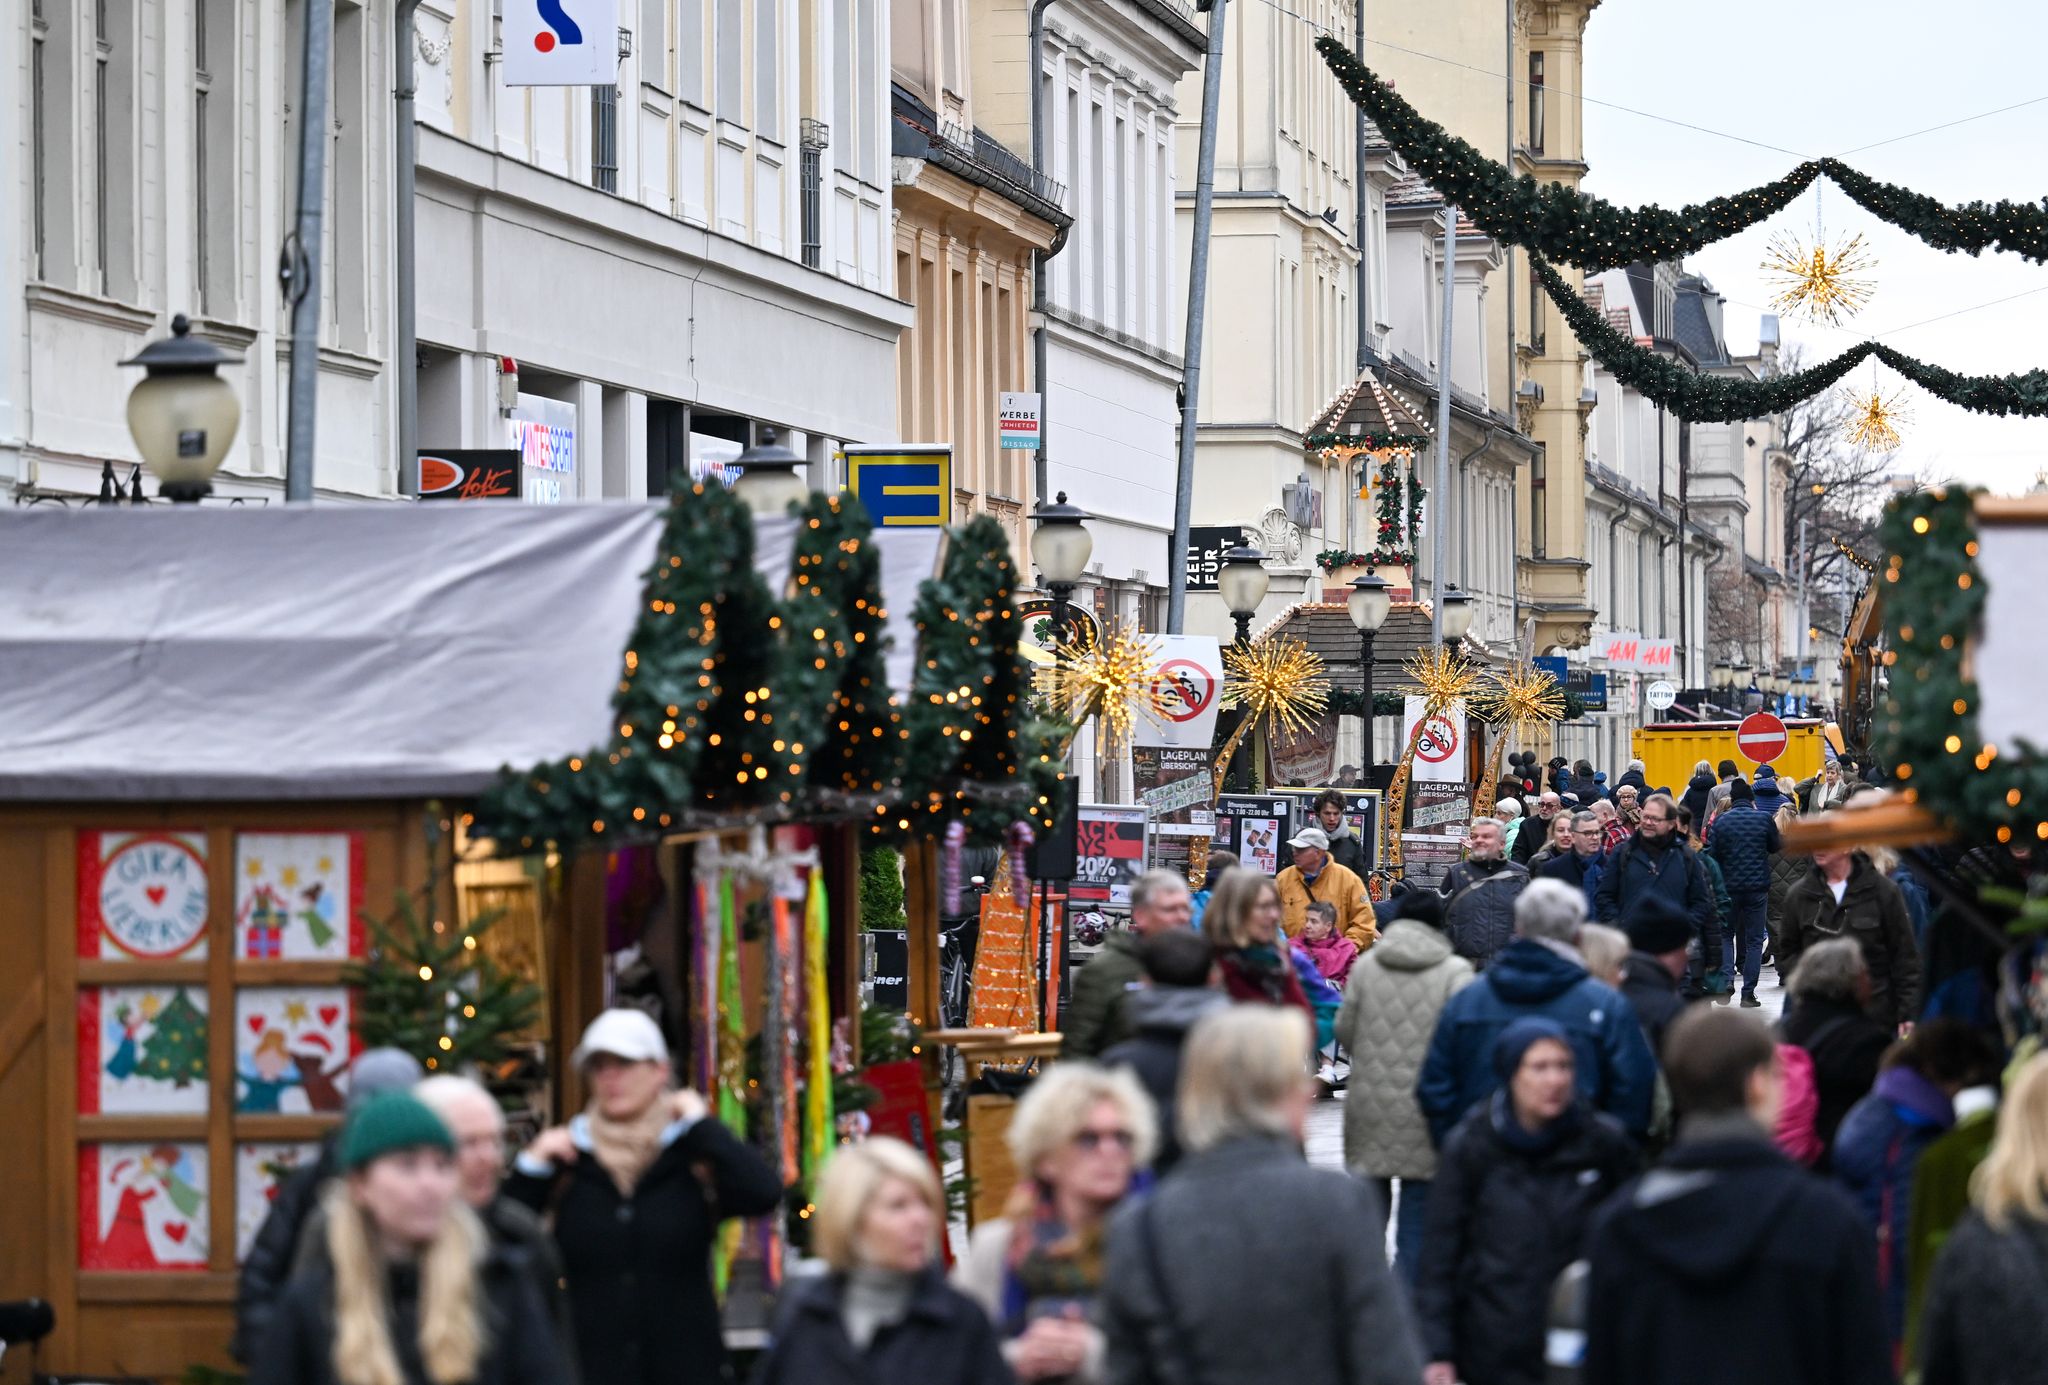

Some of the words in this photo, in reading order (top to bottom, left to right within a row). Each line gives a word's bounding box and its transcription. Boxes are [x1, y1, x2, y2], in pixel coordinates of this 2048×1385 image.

[523, 424, 574, 473] INTERSPORT
[1186, 543, 1200, 585] ZEIT
[1201, 549, 1219, 585] FÜR
[1606, 639, 1639, 662] H&M
[1641, 646, 1672, 666] H&M
[1160, 751, 1207, 761] LAGEPLAN
[1161, 761, 1198, 770] ÜBERSICHT
[1419, 784, 1466, 792] LAGEPLAN
[1078, 820, 1121, 841] ACK
[1080, 840, 1106, 856] YS
[1077, 857, 1117, 877] 20%
